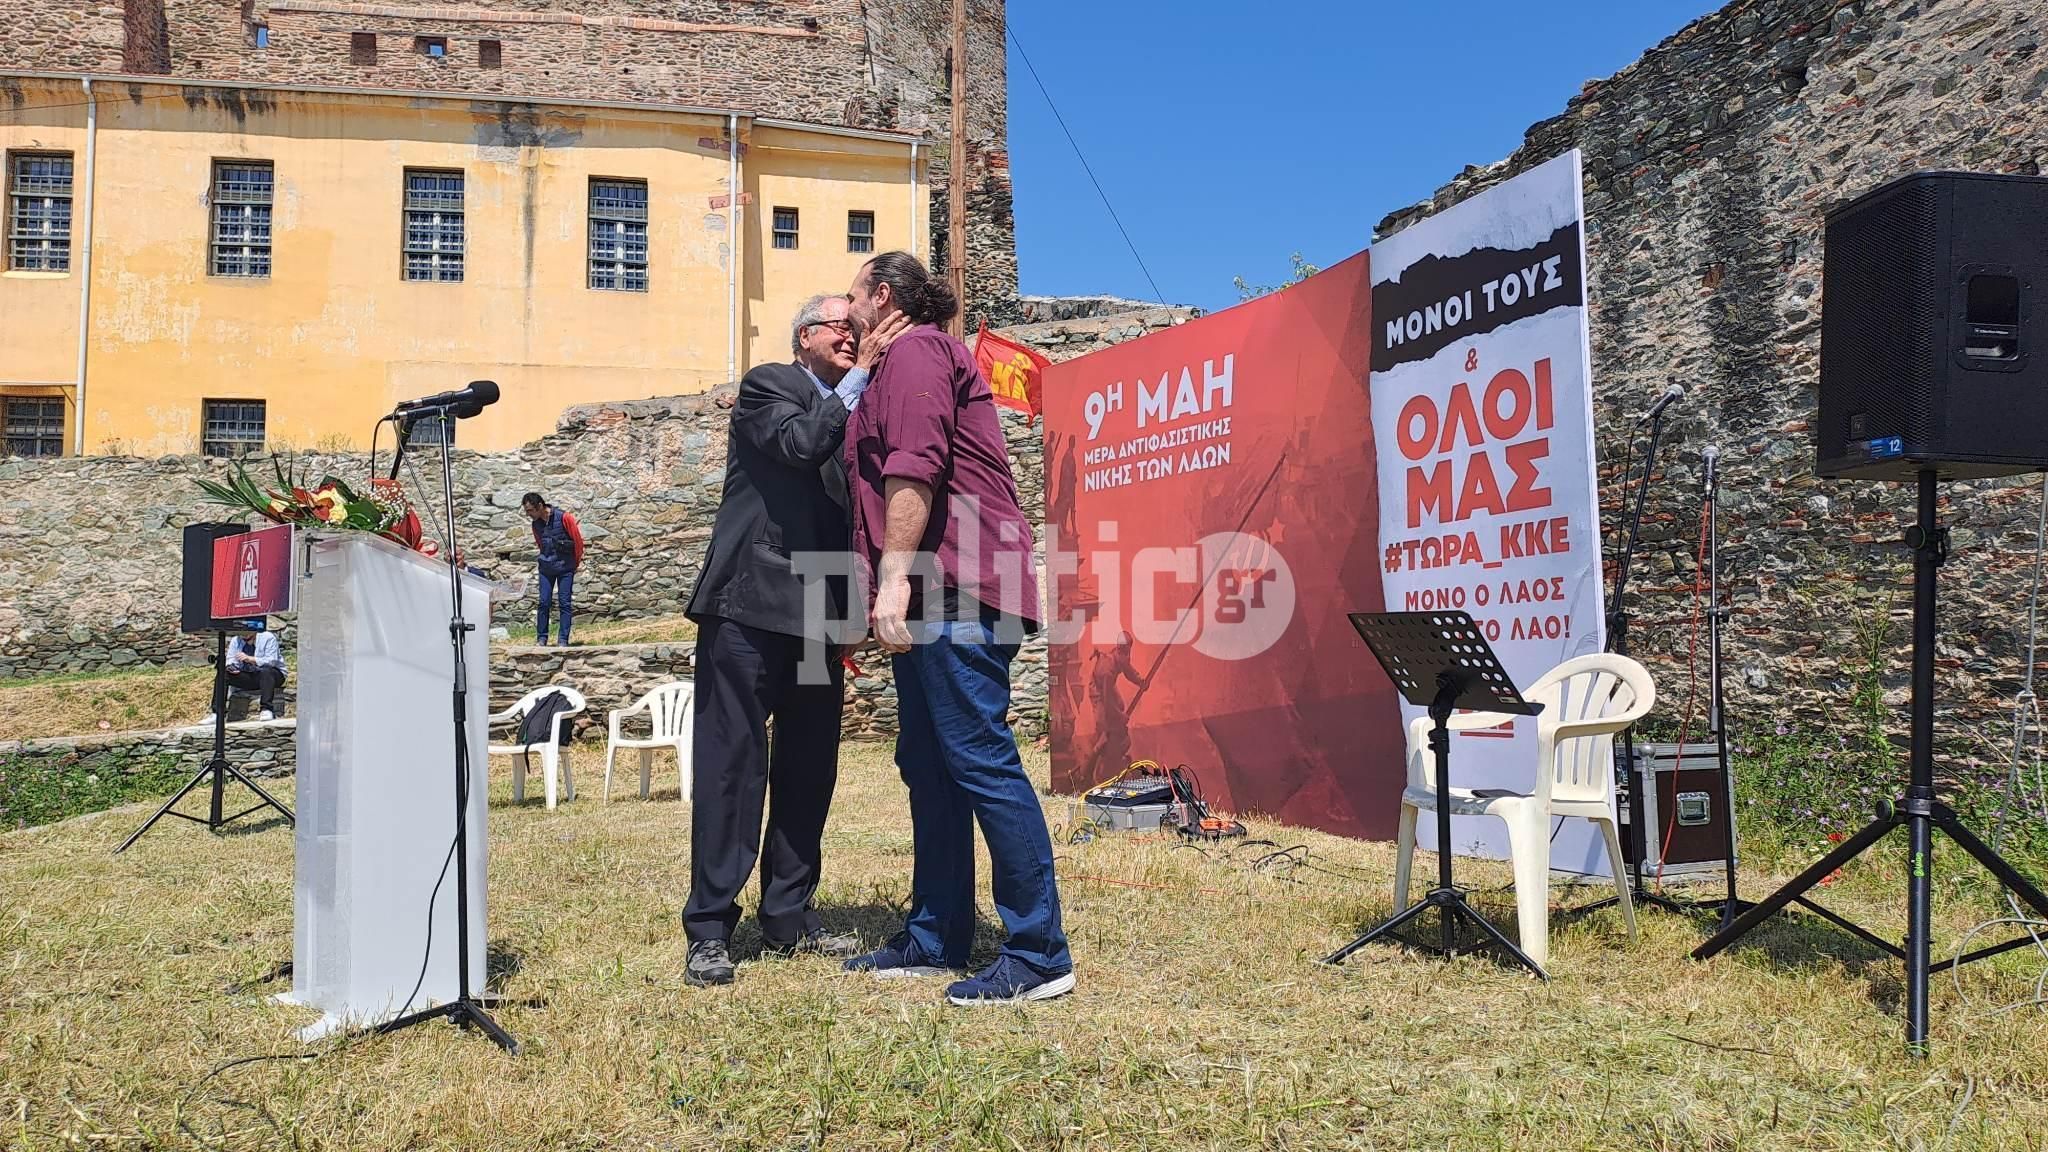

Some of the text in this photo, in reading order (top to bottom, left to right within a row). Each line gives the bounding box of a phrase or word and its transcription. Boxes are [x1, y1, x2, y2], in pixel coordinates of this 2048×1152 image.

[1386, 254, 1562, 349] ΜΟΝΟΙ ΤΟΥΣ
[1464, 347, 1478, 373] &
[1137, 353, 1234, 428] ΜΑΗ
[1397, 357, 1553, 461] ΟΛΟΙ
[1084, 416, 1231, 467] ΜΕΡΑ ΑΝΤΙΦΑΣΙΣΤΙΚΗΣ
[1084, 441, 1231, 493] ΝΙΚΗΣ ΤΩΝ ΛΑΩΝ
[1888, 438, 1901, 453] 12
[1406, 437, 1552, 529] ΜΑΣ
[1384, 516, 1570, 574] #ΤΩΡΑ_ΚΚΕ
[1405, 576, 1565, 612] ΜΟΝΟ Ο ΛΑΟΣ
[1510, 614, 1570, 641] ΛΑΟ!
